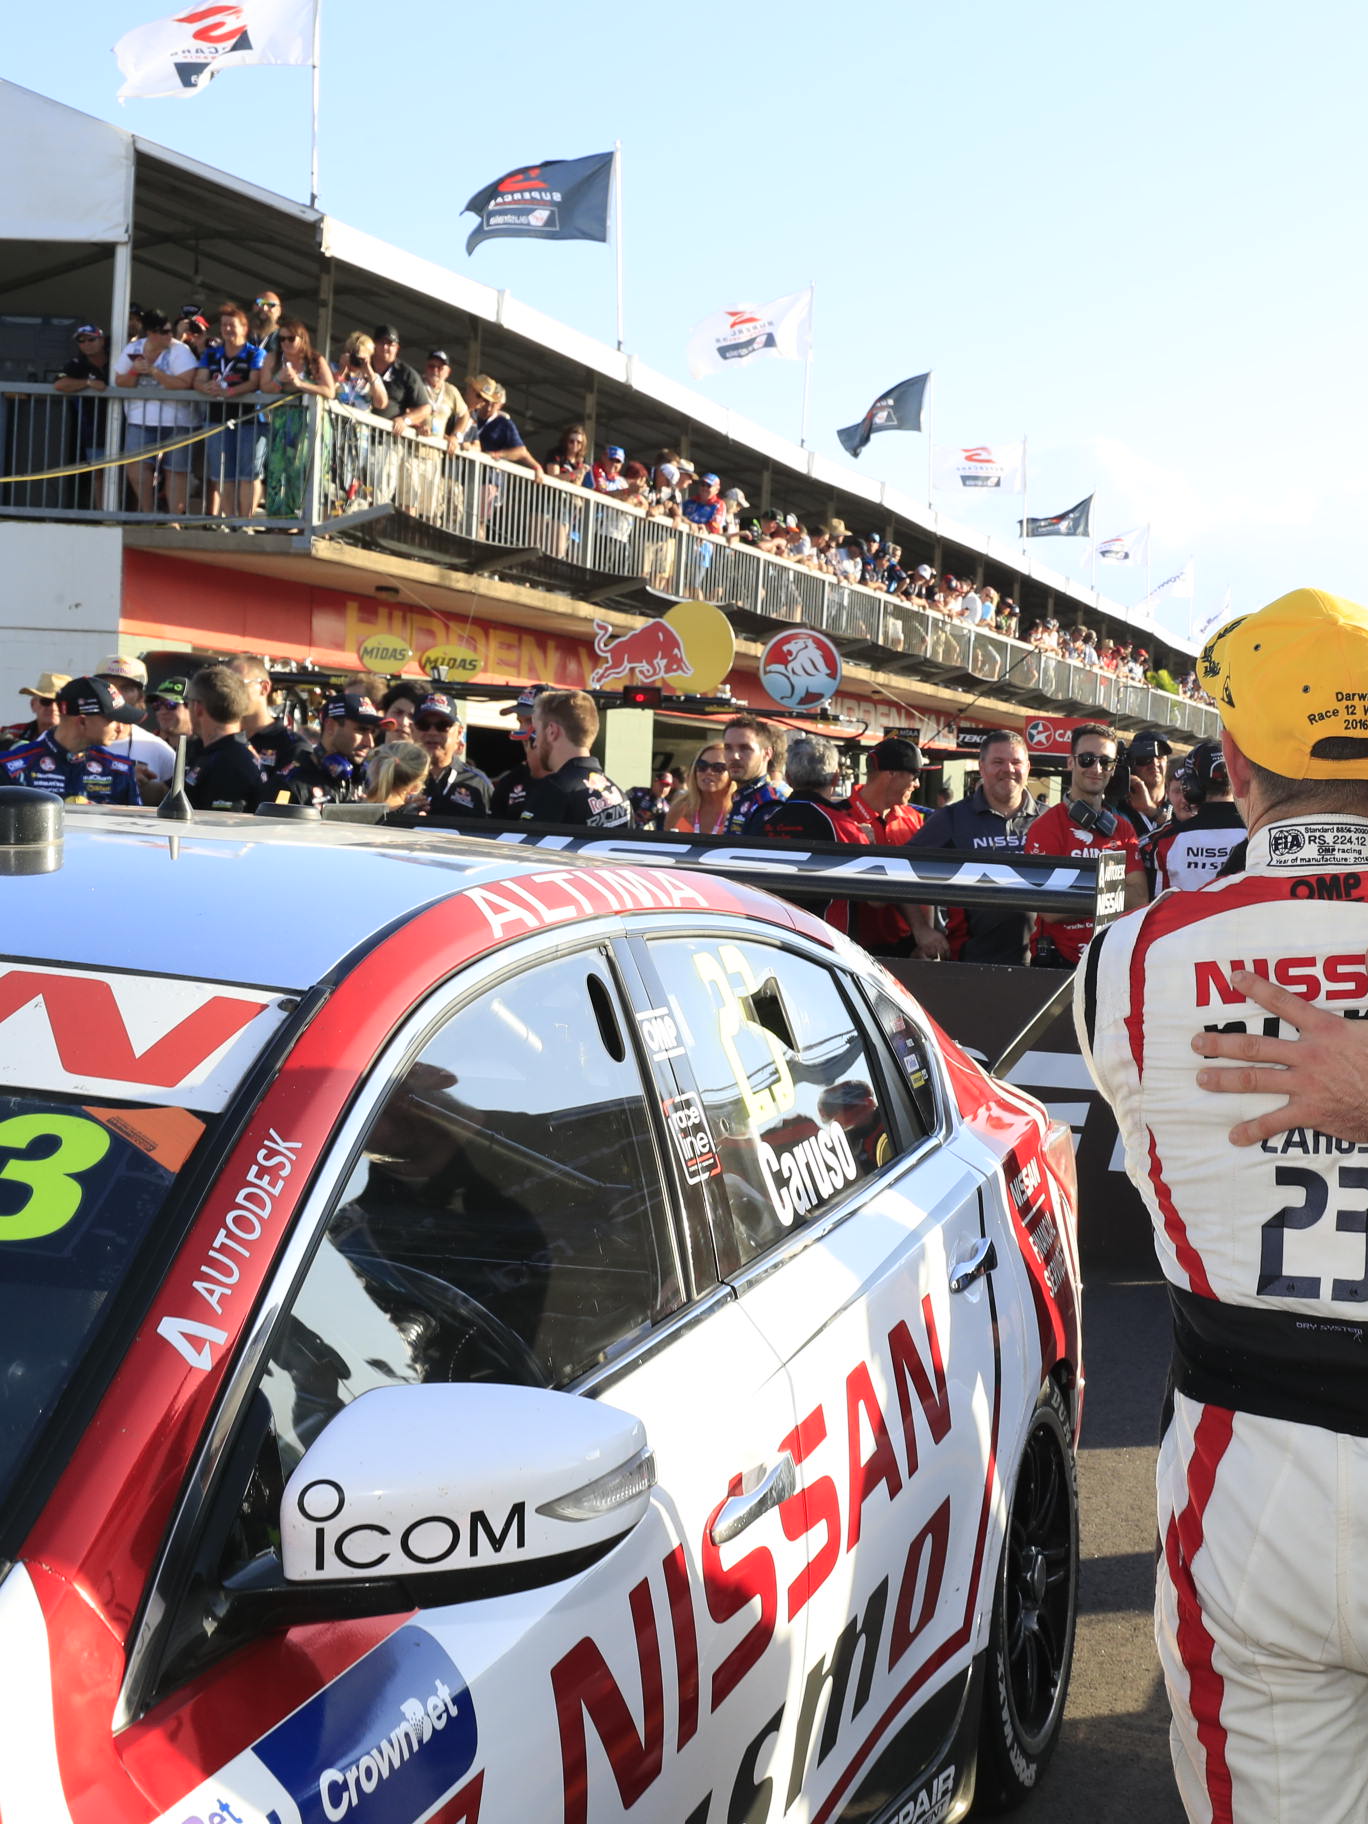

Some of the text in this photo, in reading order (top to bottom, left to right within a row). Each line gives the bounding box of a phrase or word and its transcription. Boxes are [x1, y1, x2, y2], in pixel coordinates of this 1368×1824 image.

[360, 641, 407, 661] MIDAS
[1306, 708, 1339, 725] Race
[1344, 705, 1357, 716] 12
[1343, 719, 1368, 730] 2016
[973, 835, 1028, 848] NISSA
[1272, 834, 1302, 852] FIA
[1333, 835, 1367, 846] 224.12
[1290, 872, 1361, 900] OMP
[463, 869, 709, 939] ALTIMA
[672, 1106, 701, 1130] race
[678, 1131, 710, 1161] line
[757, 1121, 858, 1227] Caruso
[192, 1128, 303, 1315] AUTODESK
[550, 1292, 952, 1824] NISSAN
[319, 1678, 458, 1823] CrownBet
